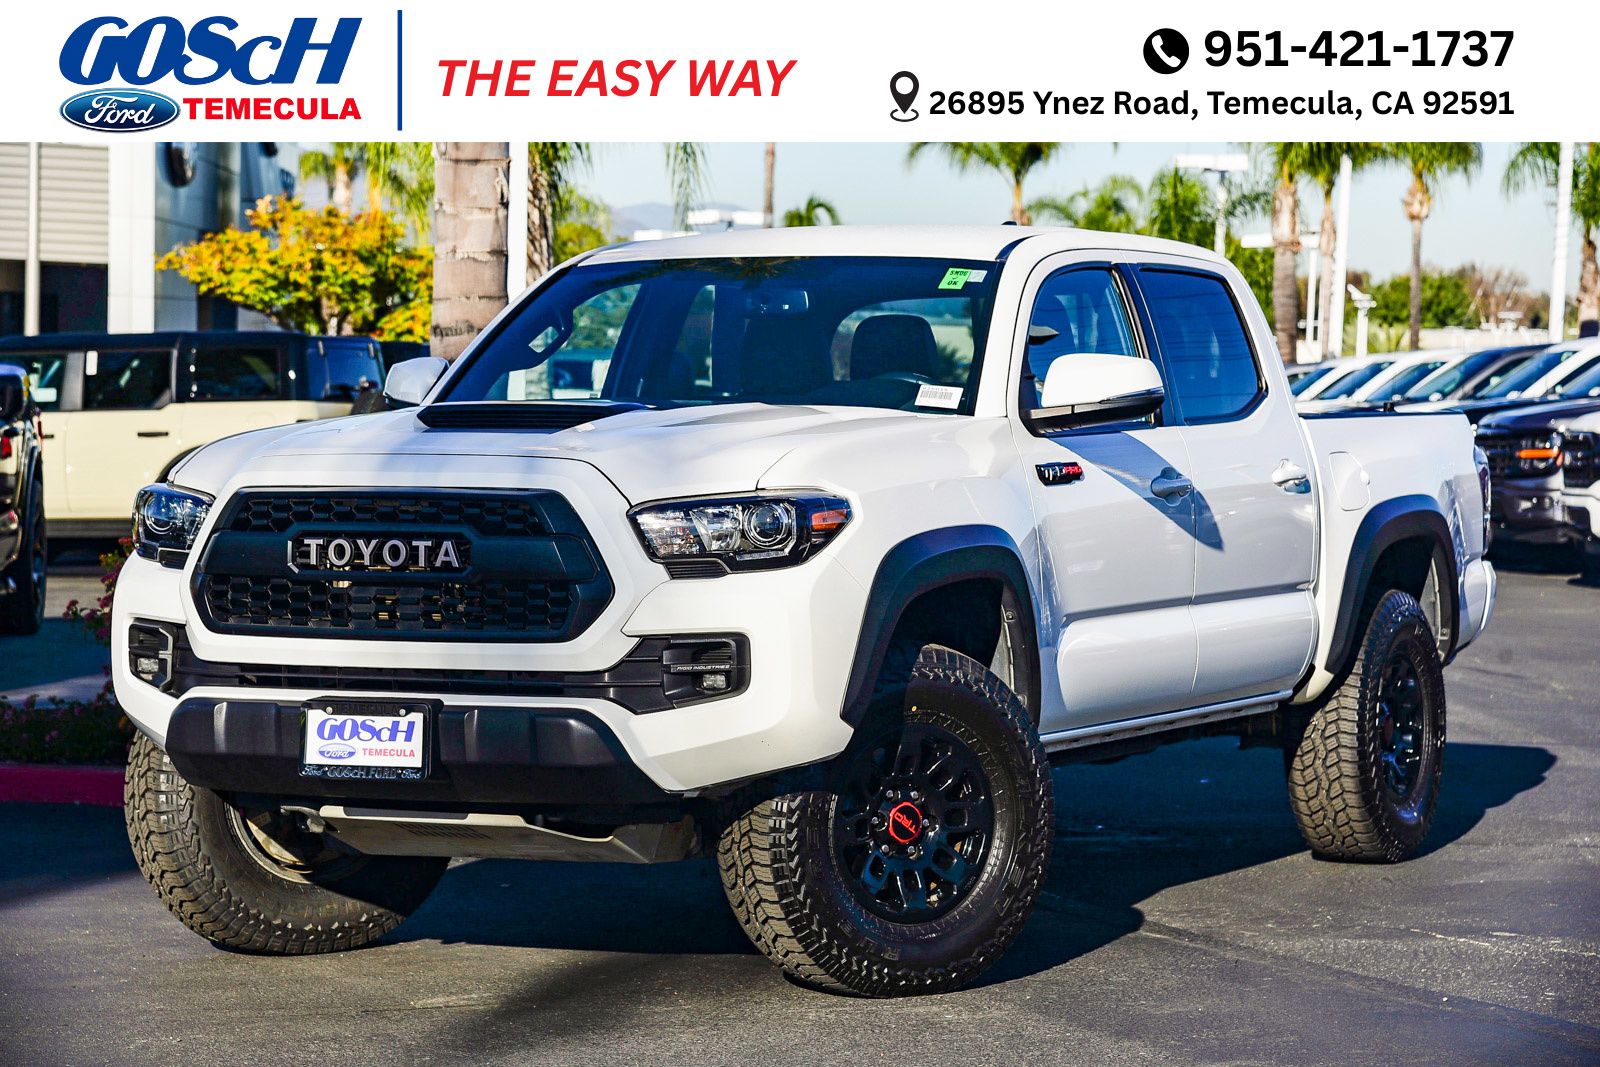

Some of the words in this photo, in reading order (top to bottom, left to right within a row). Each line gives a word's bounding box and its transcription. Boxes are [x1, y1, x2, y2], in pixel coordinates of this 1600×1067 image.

[303, 538, 461, 567] TOYOTA
[362, 748, 416, 758] TEMECULA
[893, 811, 917, 834] TRD
